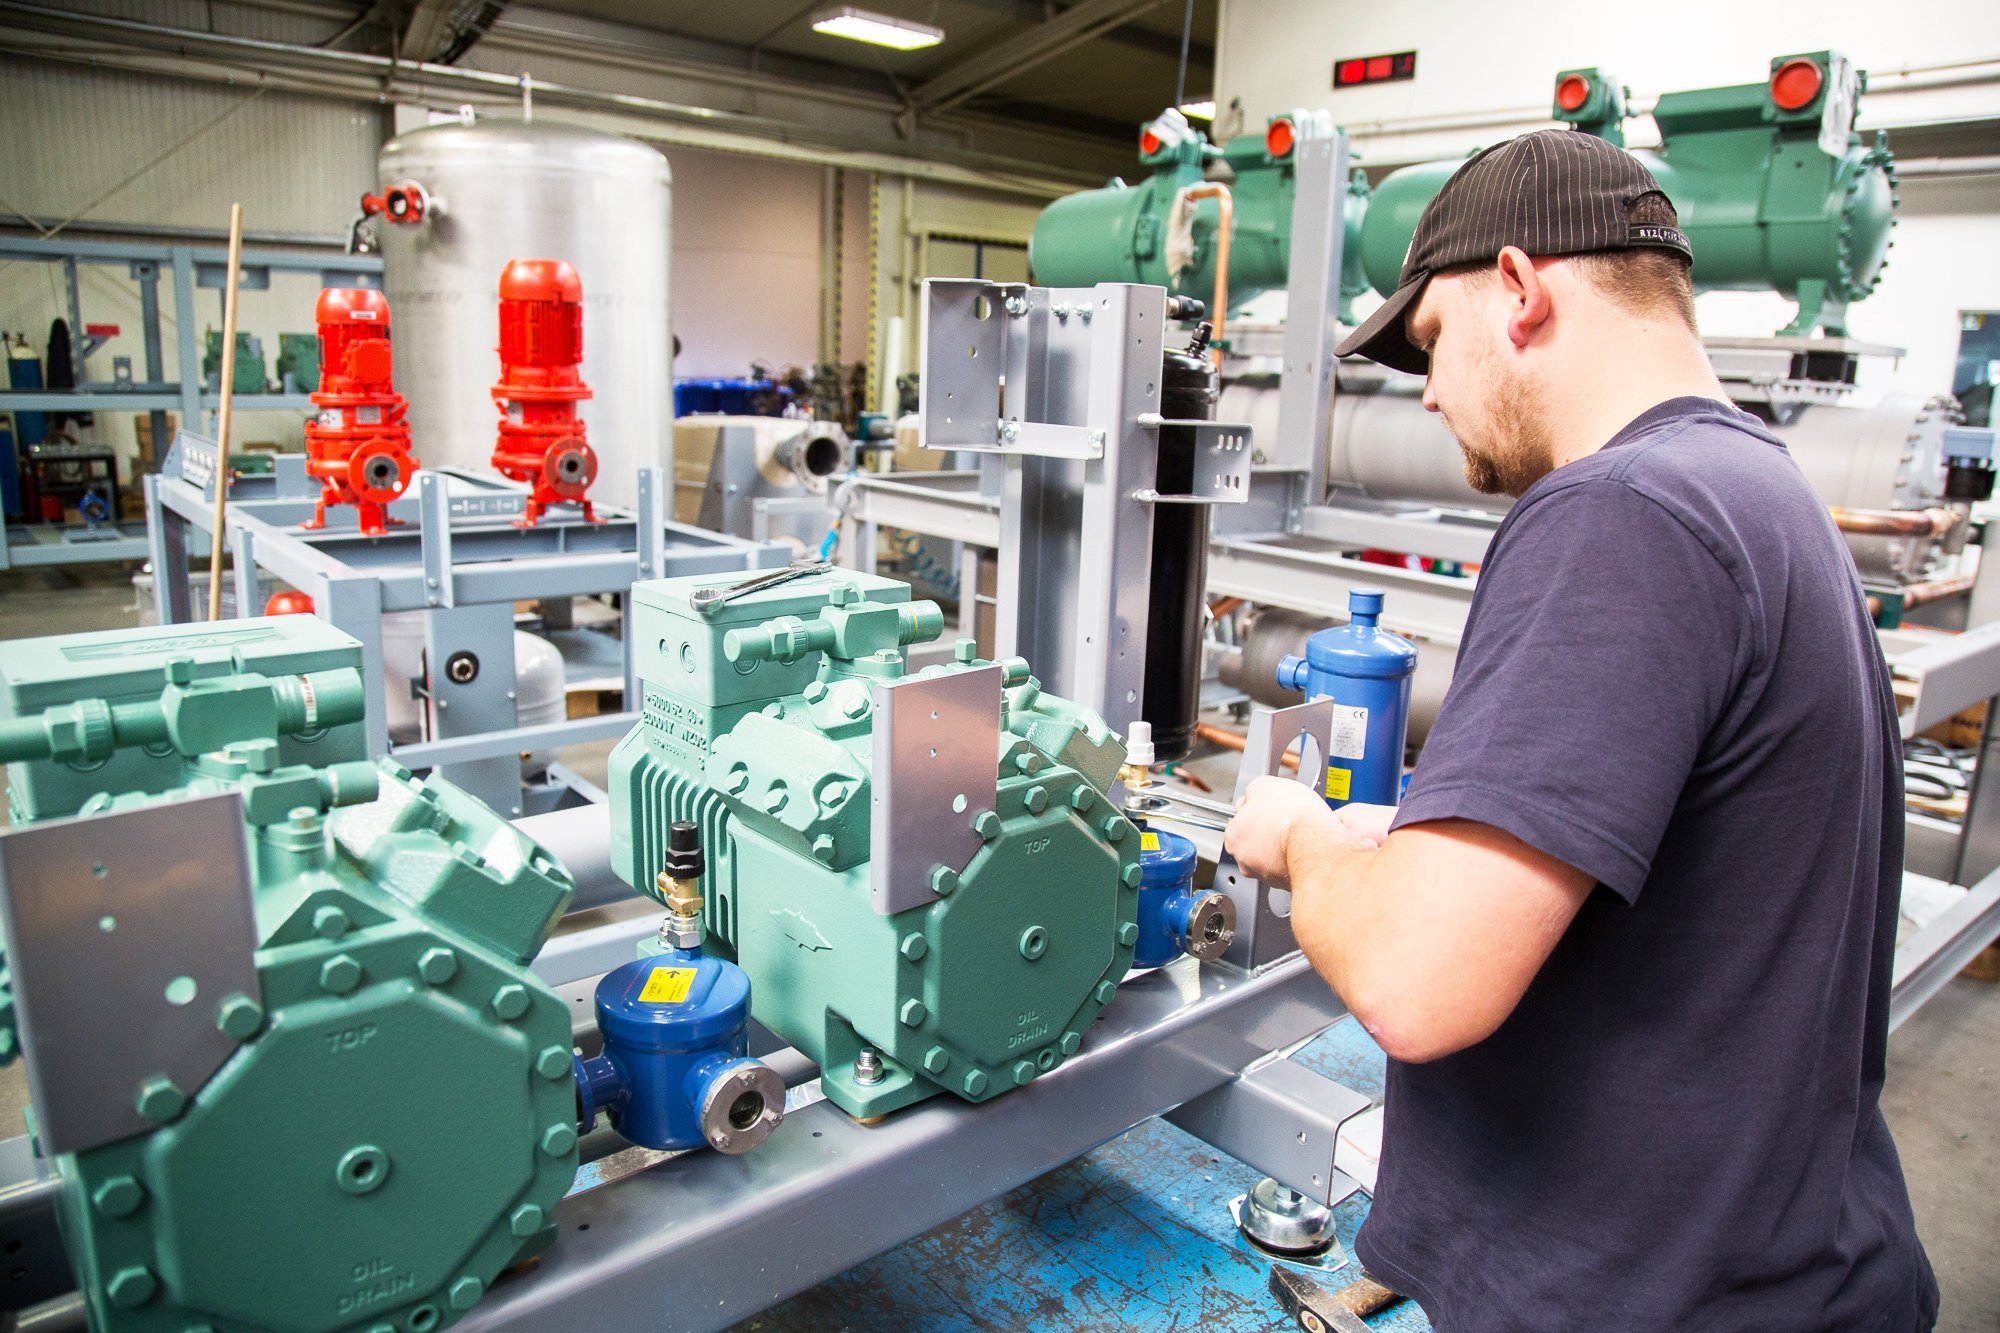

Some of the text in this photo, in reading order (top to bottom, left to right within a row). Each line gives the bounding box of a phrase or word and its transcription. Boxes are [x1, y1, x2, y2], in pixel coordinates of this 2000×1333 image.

[1024, 836, 1051, 855] TOP
[1017, 1010, 1039, 1026] OIL
[324, 1023, 378, 1054] TOP
[1007, 1023, 1047, 1048] DRAIN
[352, 1258, 394, 1282] OIL
[338, 1272, 415, 1316] DRAIN
